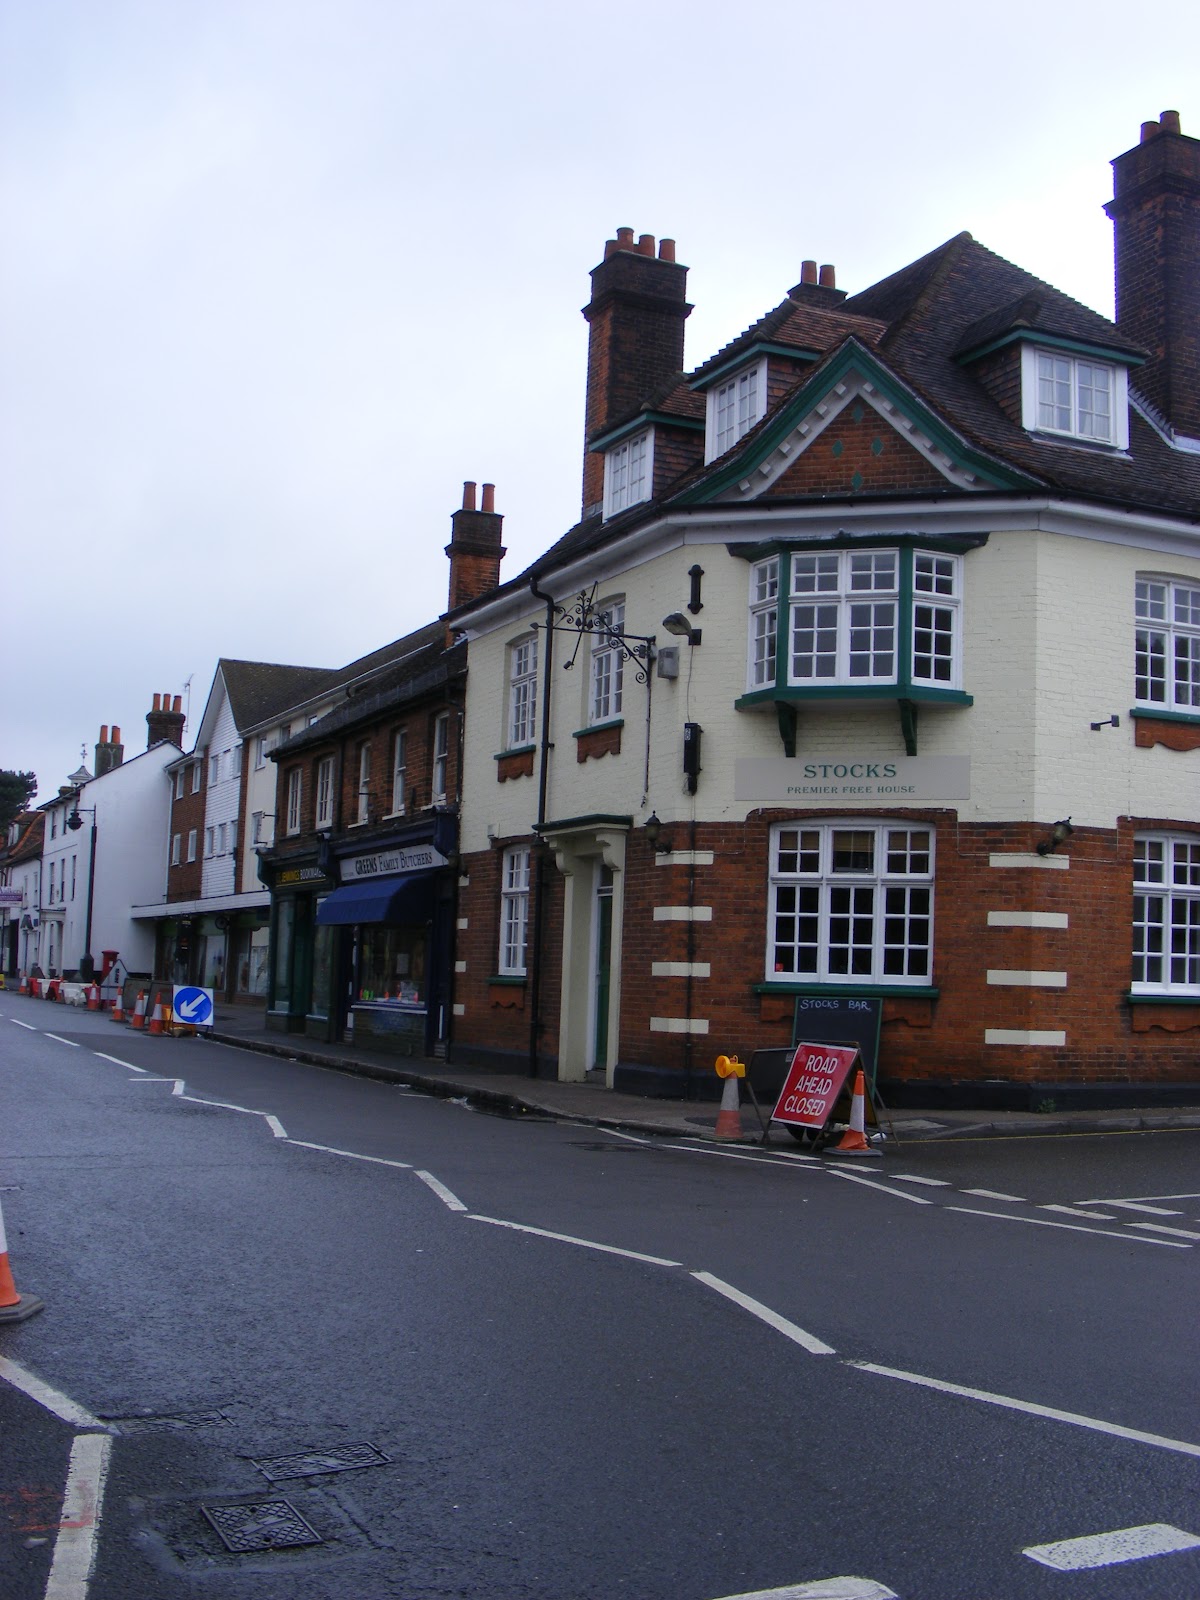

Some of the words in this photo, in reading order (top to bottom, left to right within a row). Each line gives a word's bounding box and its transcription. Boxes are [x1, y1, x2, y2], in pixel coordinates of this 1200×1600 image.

[803, 764, 897, 778] STOCKS
[787, 786, 838, 794] PREMIER
[842, 786, 872, 794] FREE
[877, 785, 915, 793] HOUSE
[355, 857, 378, 875] GREENS
[800, 1000, 839, 1009] STOCKS
[805, 1054, 839, 1075] ROAD
[794, 1075, 833, 1095] AHEAD
[784, 1095, 826, 1116] CLOSED
